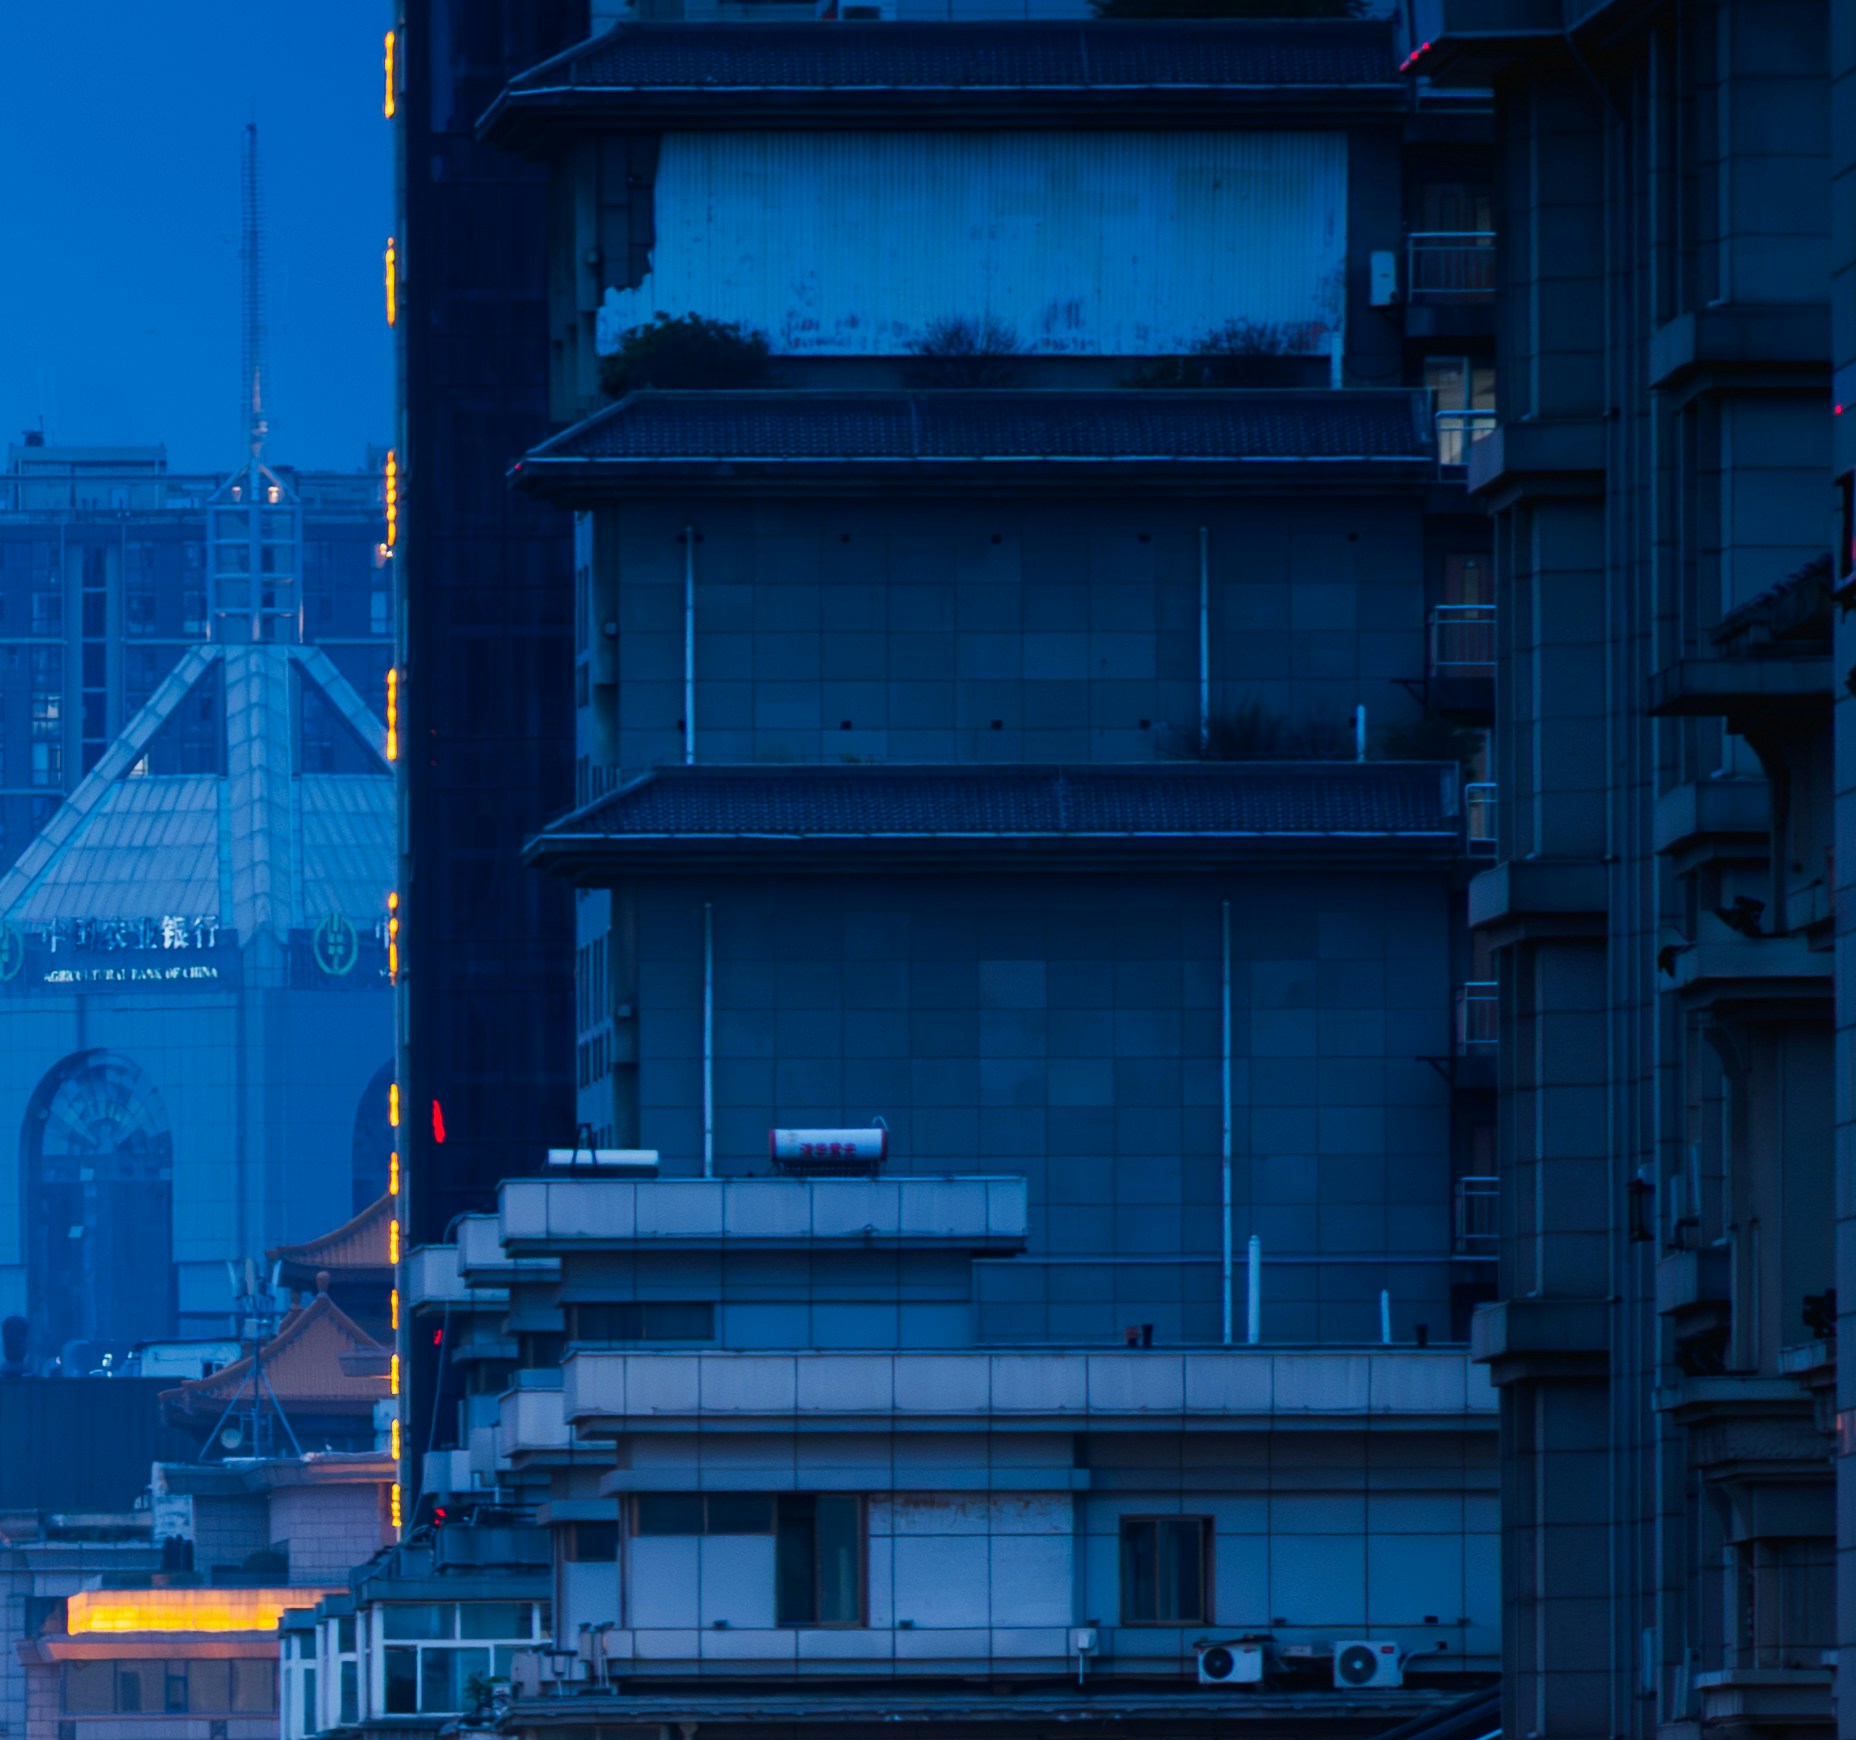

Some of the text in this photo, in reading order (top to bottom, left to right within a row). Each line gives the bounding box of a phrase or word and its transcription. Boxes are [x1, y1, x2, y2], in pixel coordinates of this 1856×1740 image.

[41, 913, 220, 955] 中国农业银行
[165, 966, 179, 980] OF
[180, 964, 220, 981] CHINA
